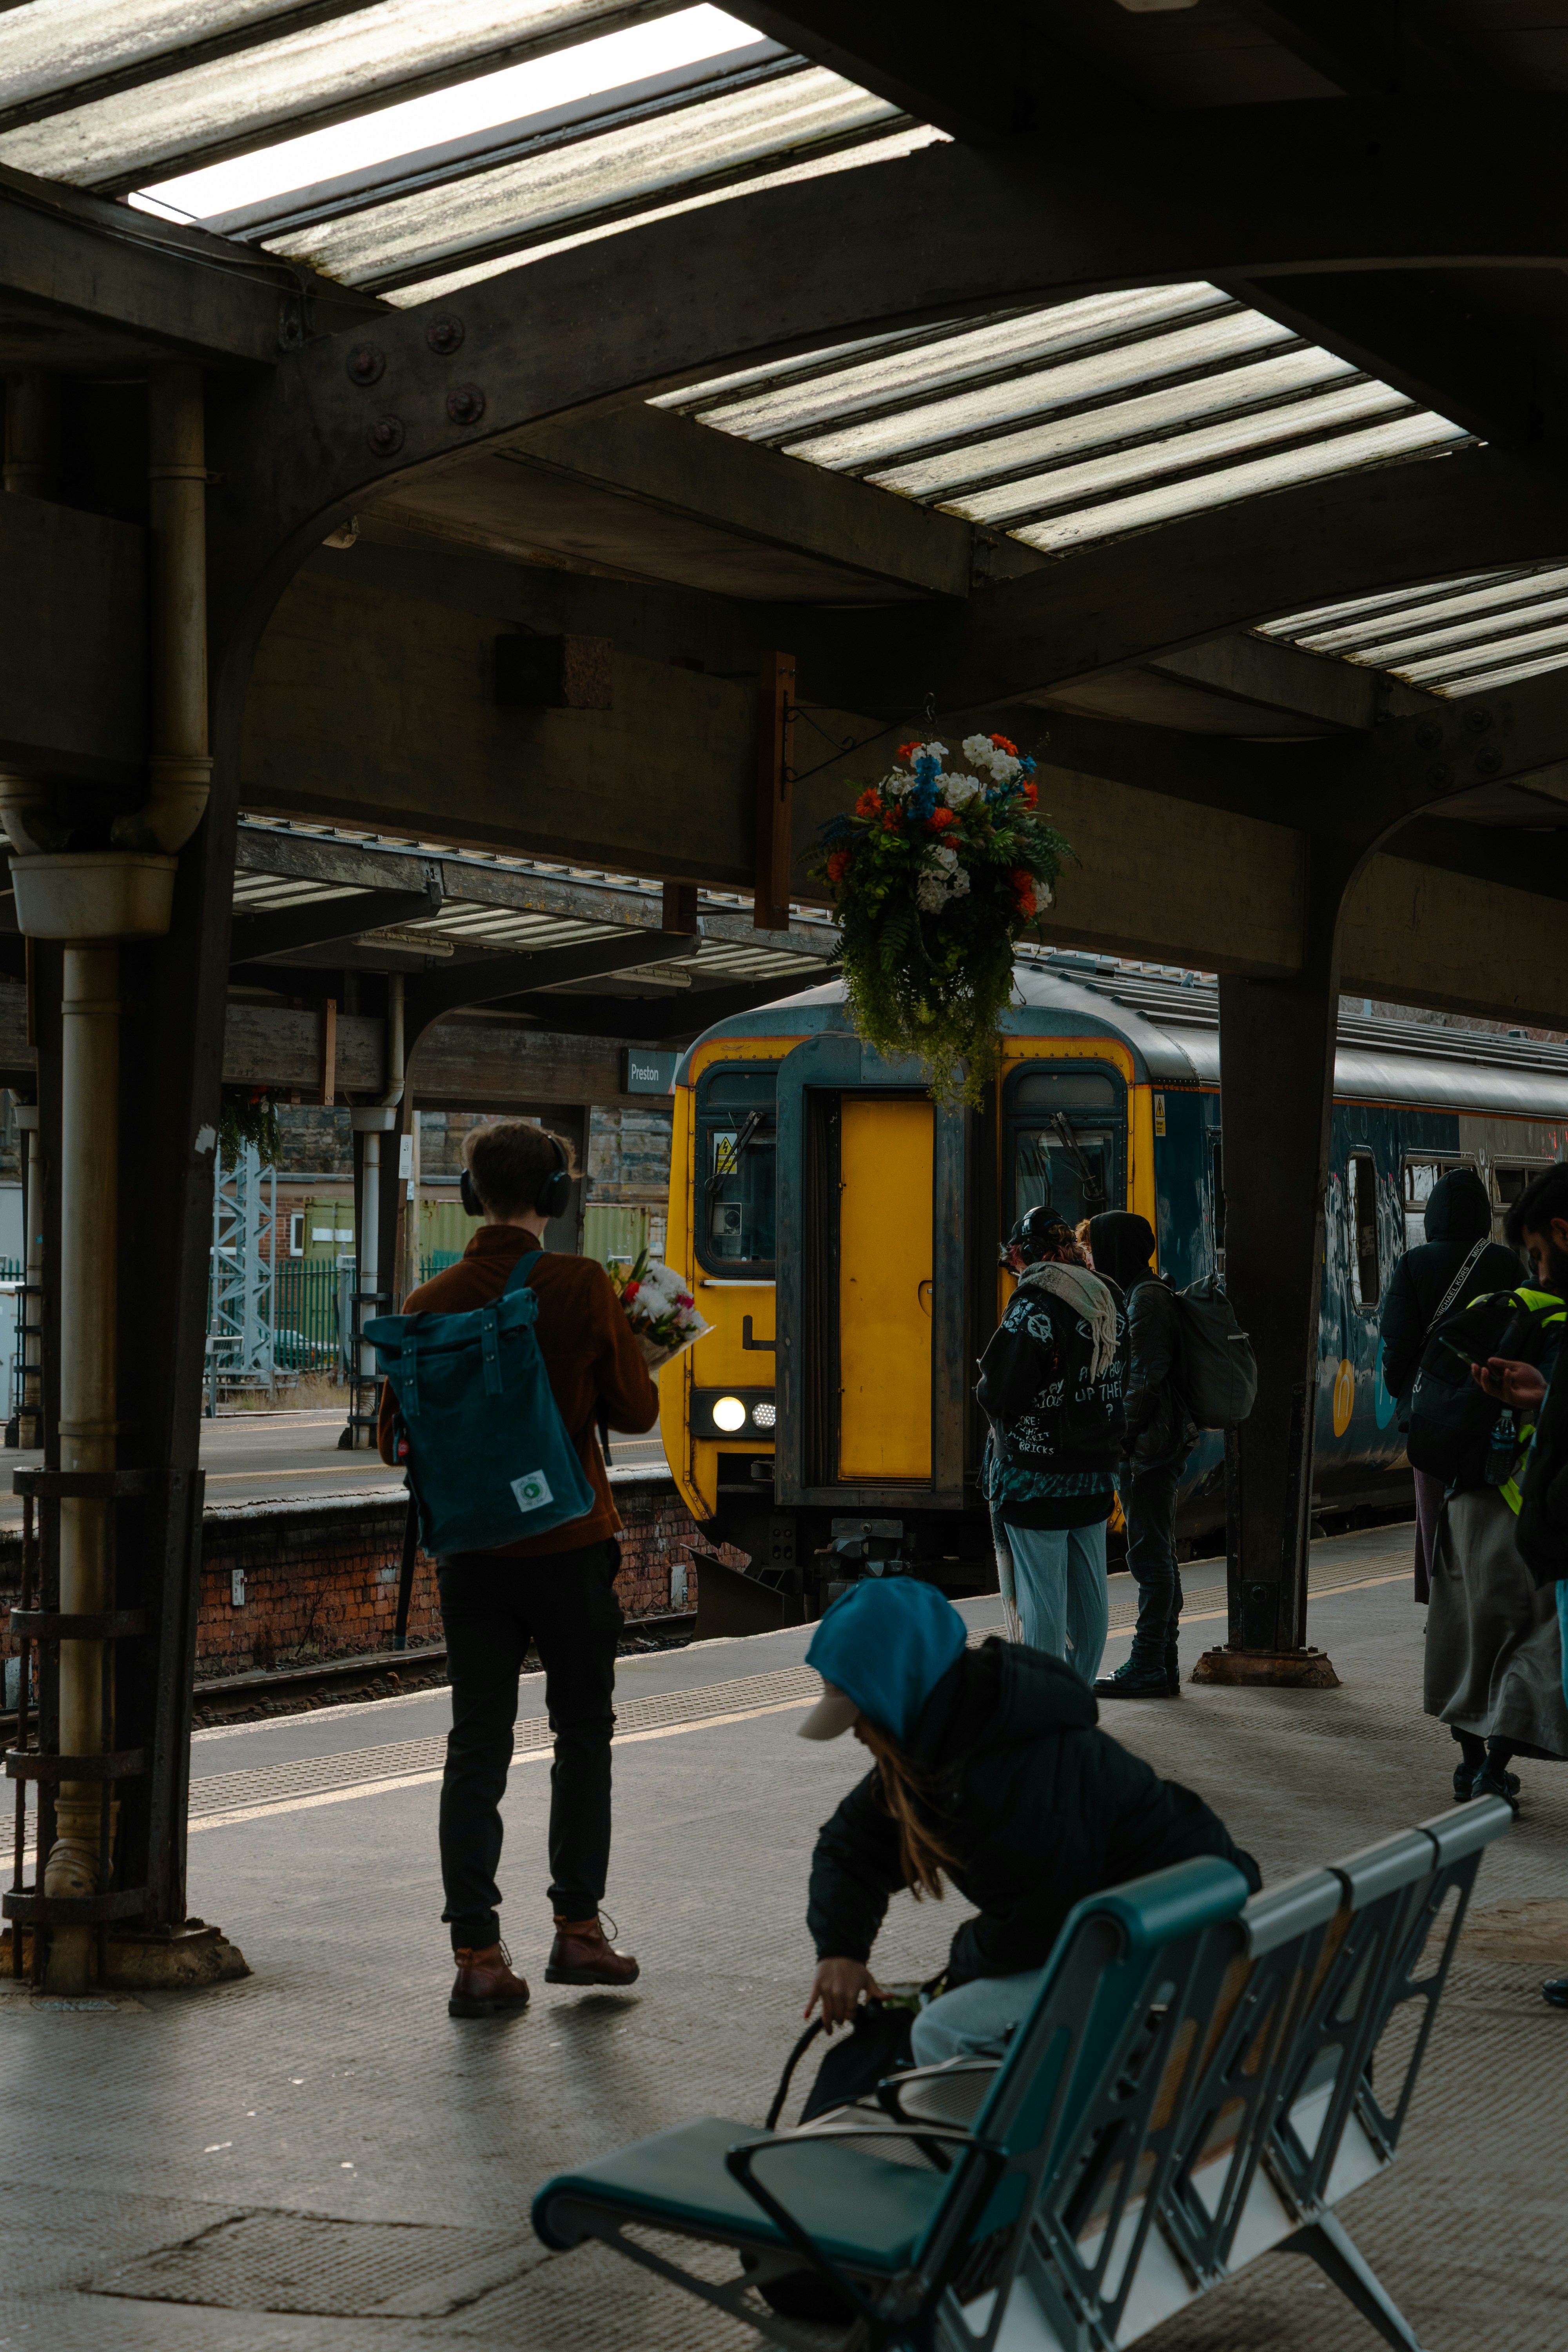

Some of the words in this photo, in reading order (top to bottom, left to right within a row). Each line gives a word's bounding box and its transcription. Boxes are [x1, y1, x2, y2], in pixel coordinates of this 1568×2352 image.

[631, 1063, 659, 1081] Preston
[1437, 1286, 1458, 1318] MICHAEL
[1455, 1266, 1469, 1286] KORS
[1075, 1387, 1095, 1402] UP
[1019, 1416, 1040, 1425] ORE:
[1105, 1403, 1113, 1422] ?
[1019, 1442, 1054, 1455] BRICKS
